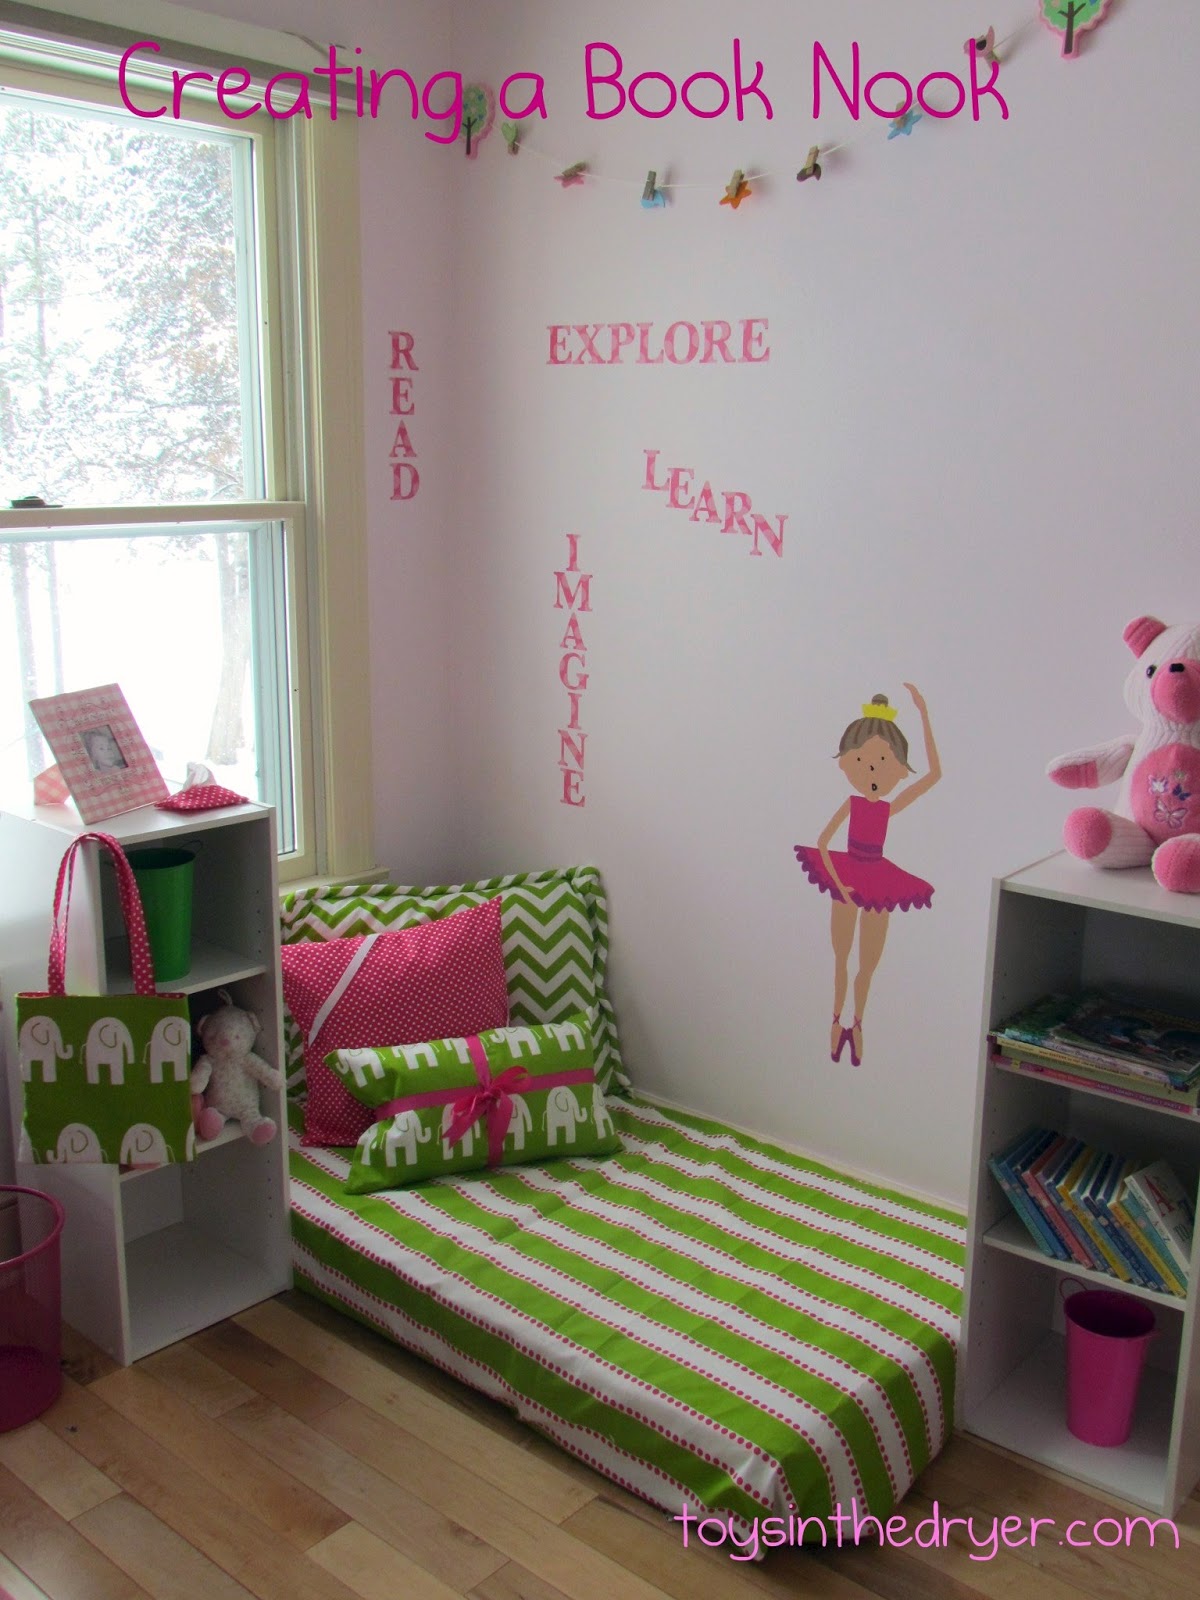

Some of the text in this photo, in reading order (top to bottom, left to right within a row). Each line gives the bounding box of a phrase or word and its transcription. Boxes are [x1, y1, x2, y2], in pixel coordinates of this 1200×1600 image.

[546, 318, 771, 365] EXPLORE
[388, 330, 420, 502] READ
[641, 449, 789, 558] LEARN
[553, 533, 594, 808] IMAGINE
